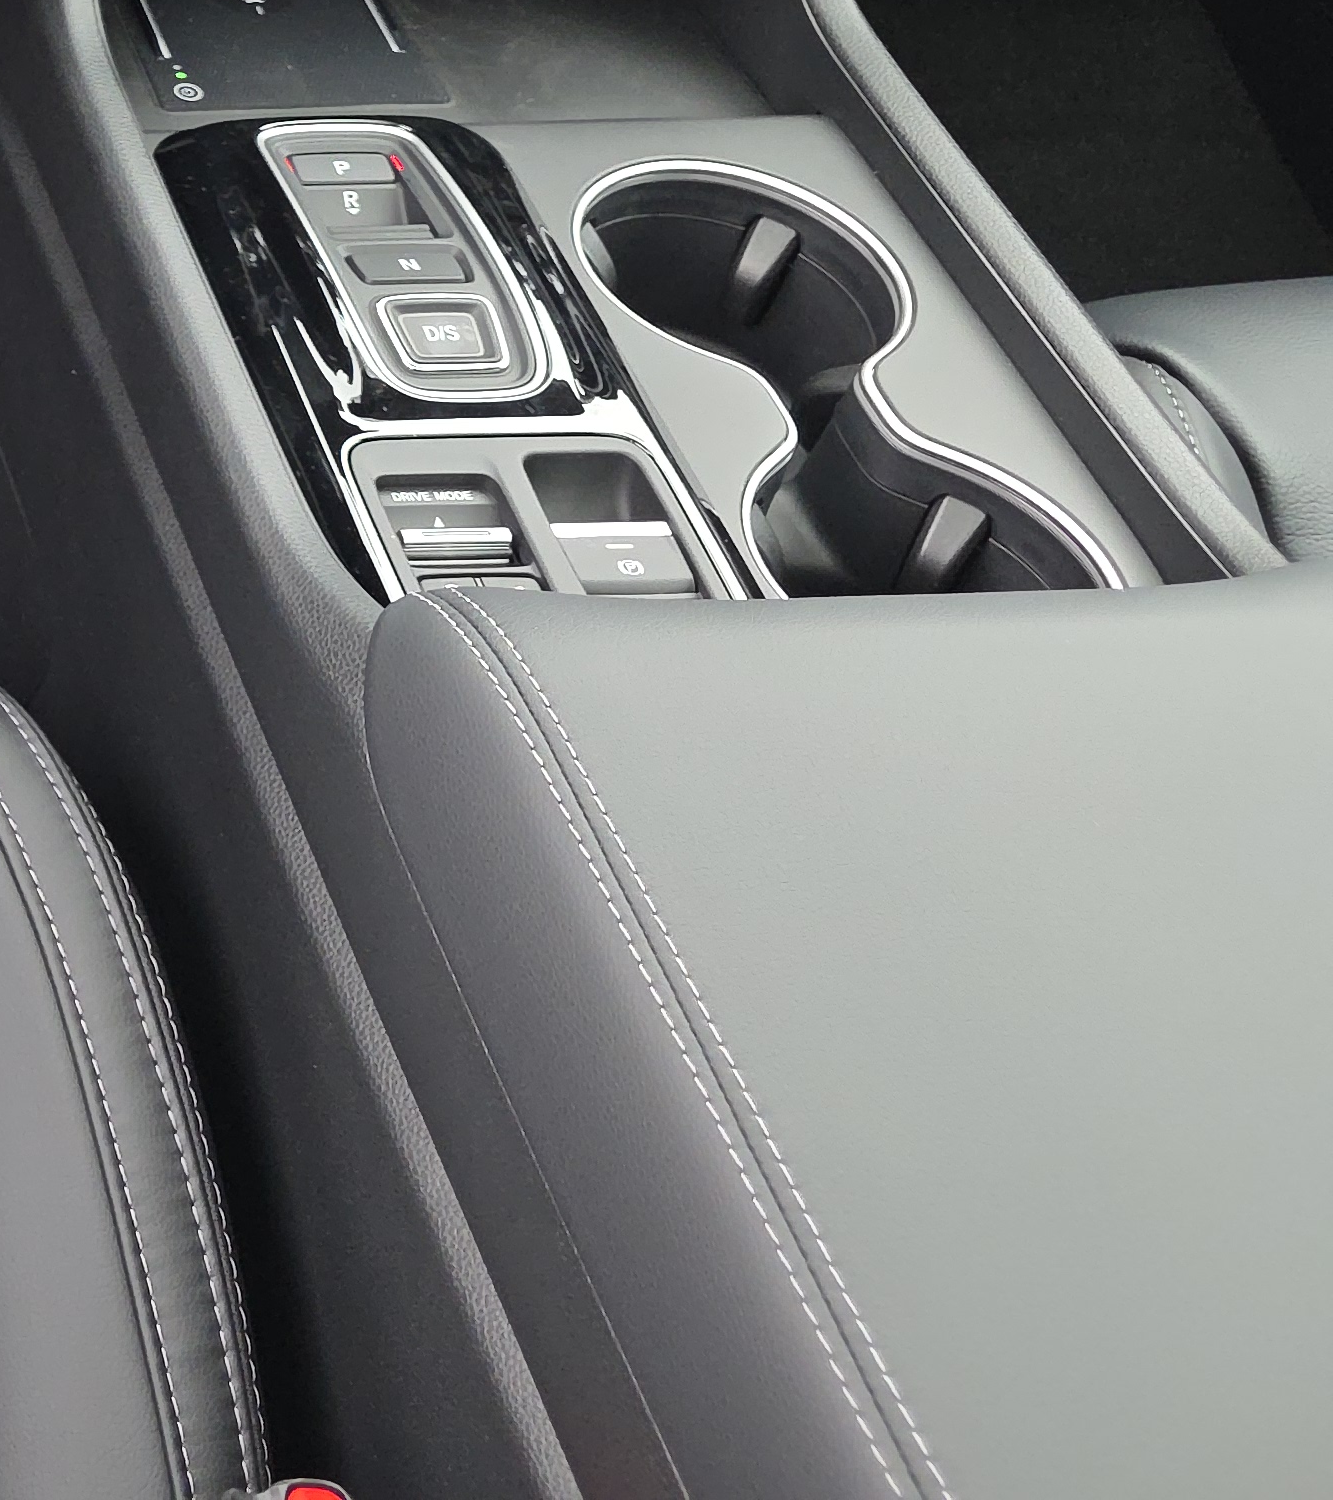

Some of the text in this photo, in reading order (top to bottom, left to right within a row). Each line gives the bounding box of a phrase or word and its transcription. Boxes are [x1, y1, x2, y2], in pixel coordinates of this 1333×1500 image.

[333, 160, 350, 176] P
[342, 190, 359, 209] R
[399, 258, 421, 271] N
[422, 325, 460, 341] D/S
[391, 489, 474, 502] DRIVE MODE
